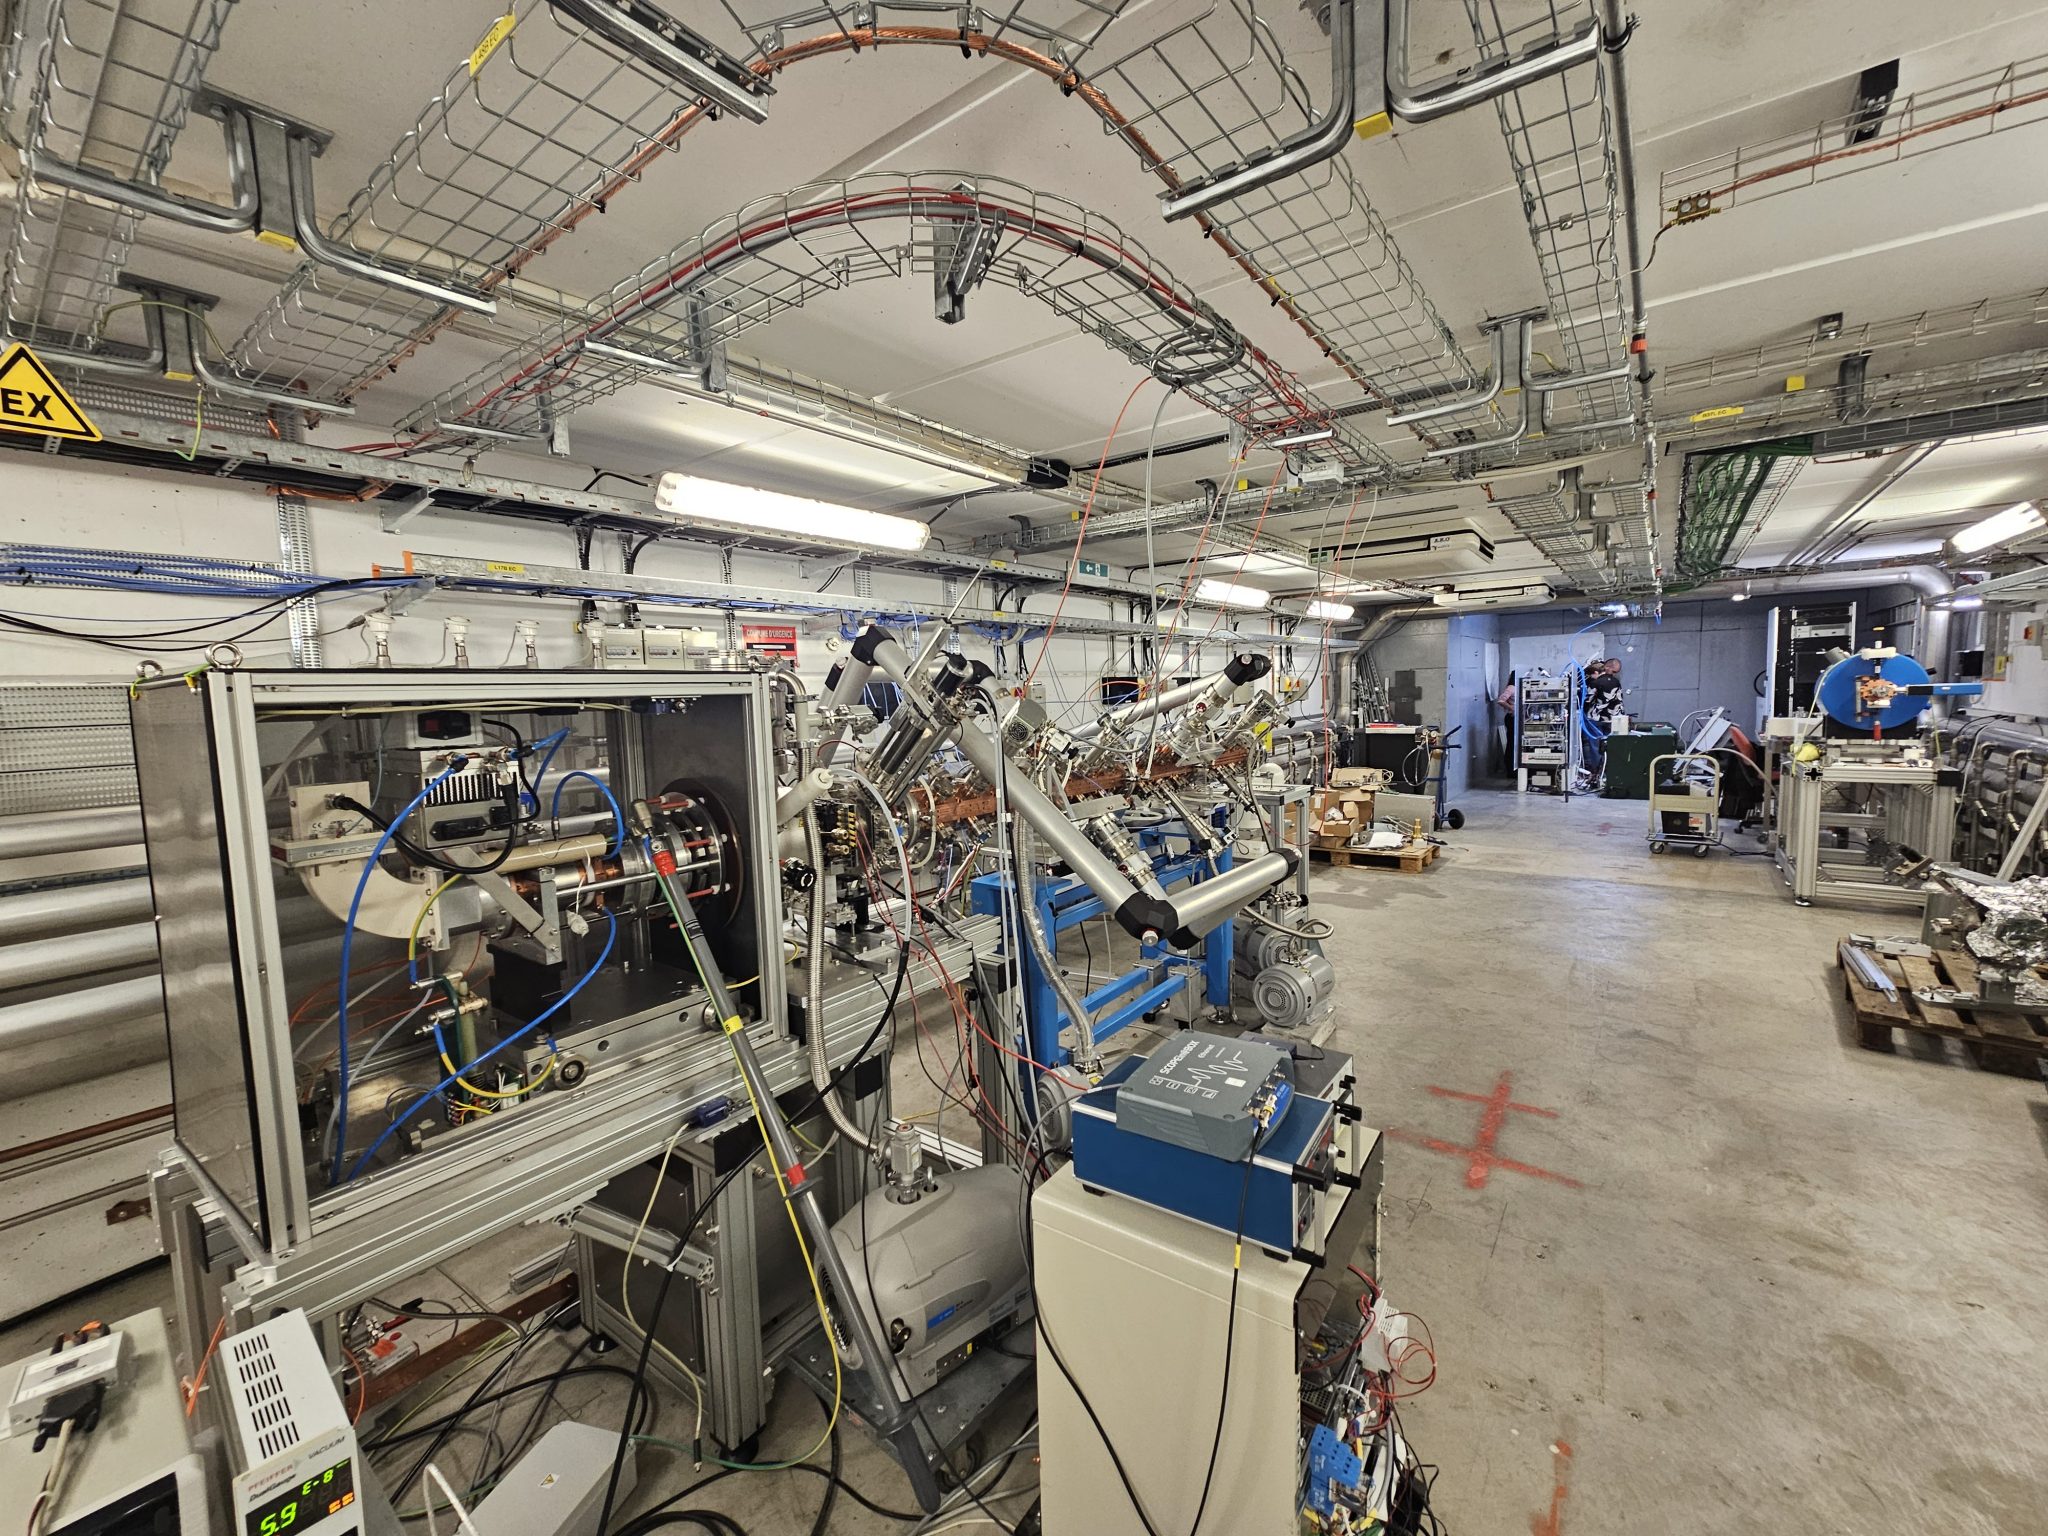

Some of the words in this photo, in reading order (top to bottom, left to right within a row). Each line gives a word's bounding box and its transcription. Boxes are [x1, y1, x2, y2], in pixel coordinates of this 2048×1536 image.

[1, 387, 55, 421] EX
[248, 1464, 294, 1492] PFEIFFER
[308, 1436, 345, 1460] VACUUM
